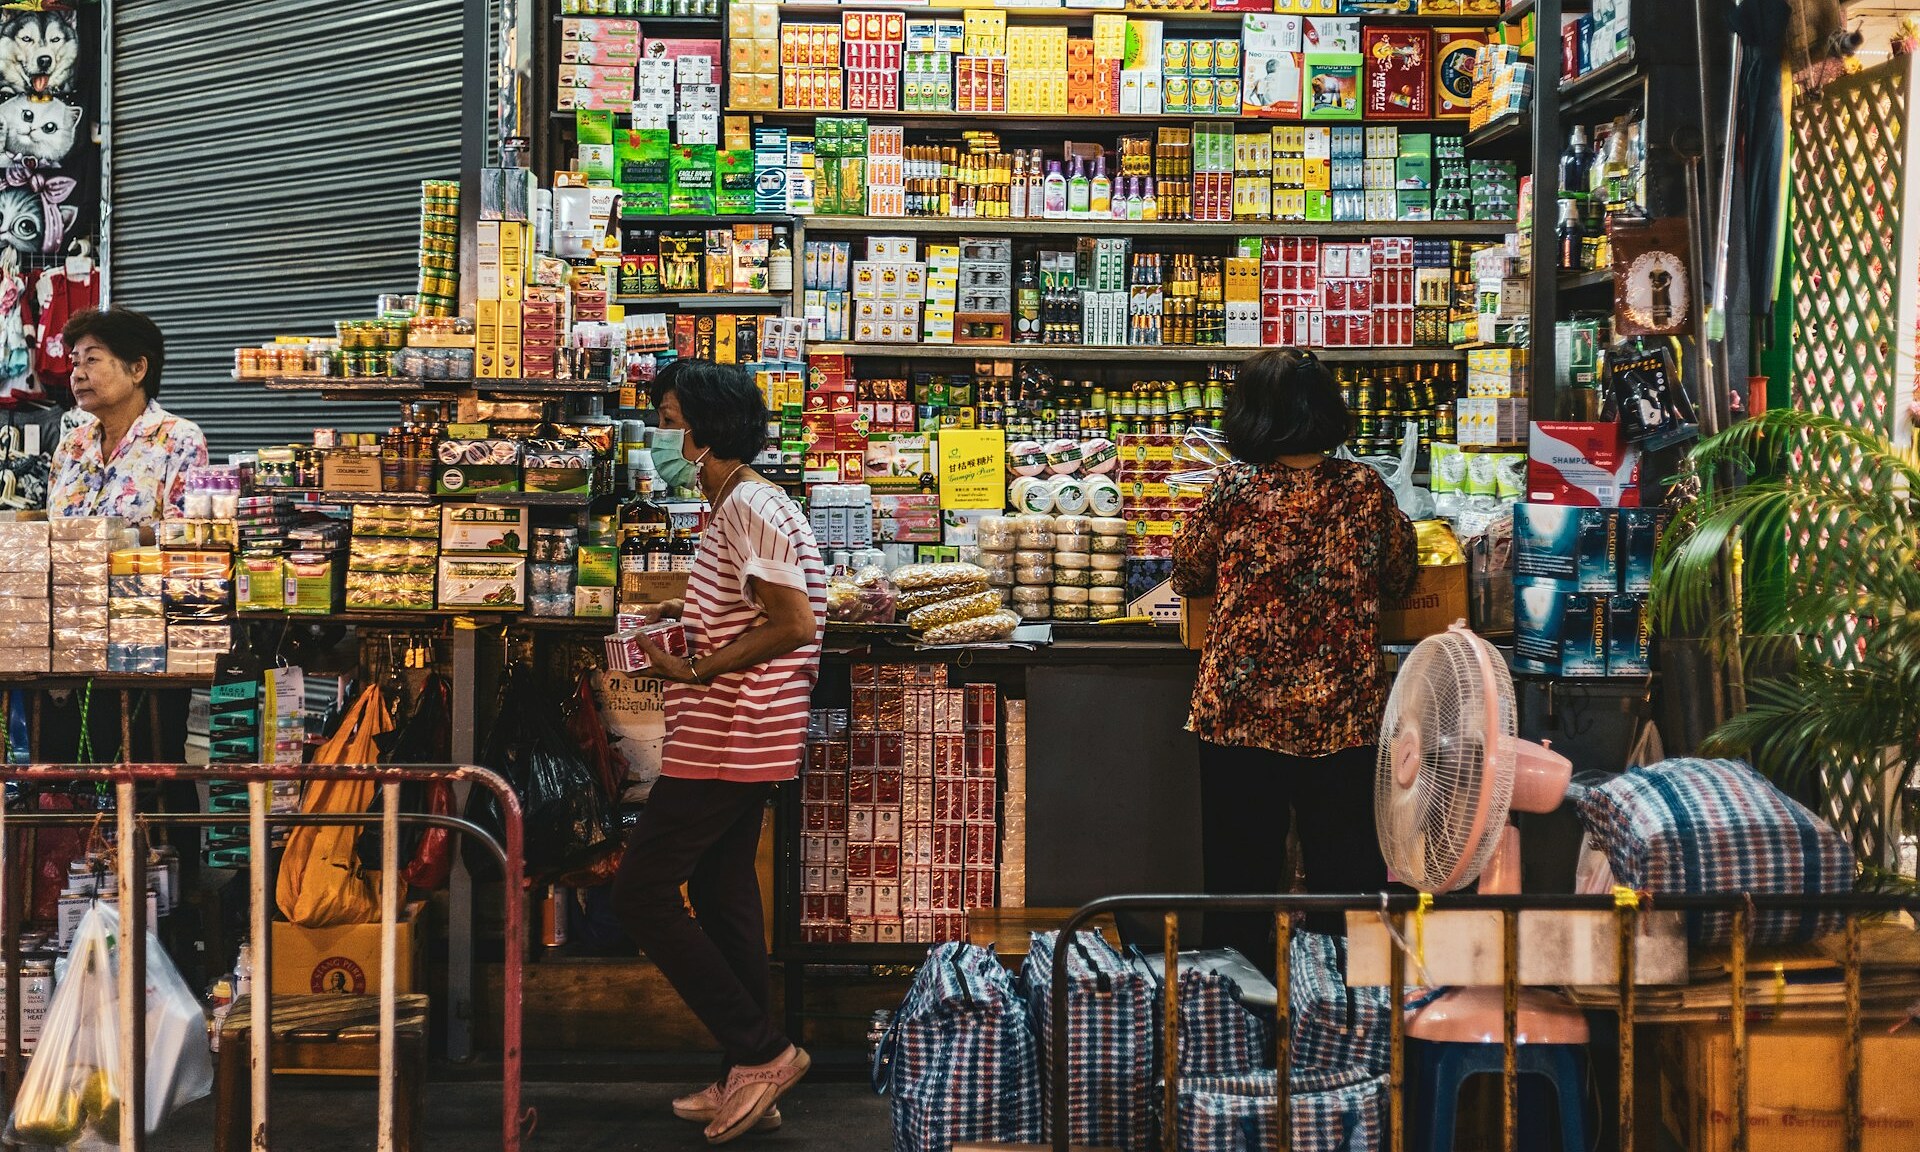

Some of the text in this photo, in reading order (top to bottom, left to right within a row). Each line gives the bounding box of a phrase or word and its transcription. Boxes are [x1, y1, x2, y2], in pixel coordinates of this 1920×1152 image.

[1609, 512, 1618, 574] Treatment
[1595, 598, 1606, 658] Treatment
[315, 959, 362, 979] SIANG PURE
